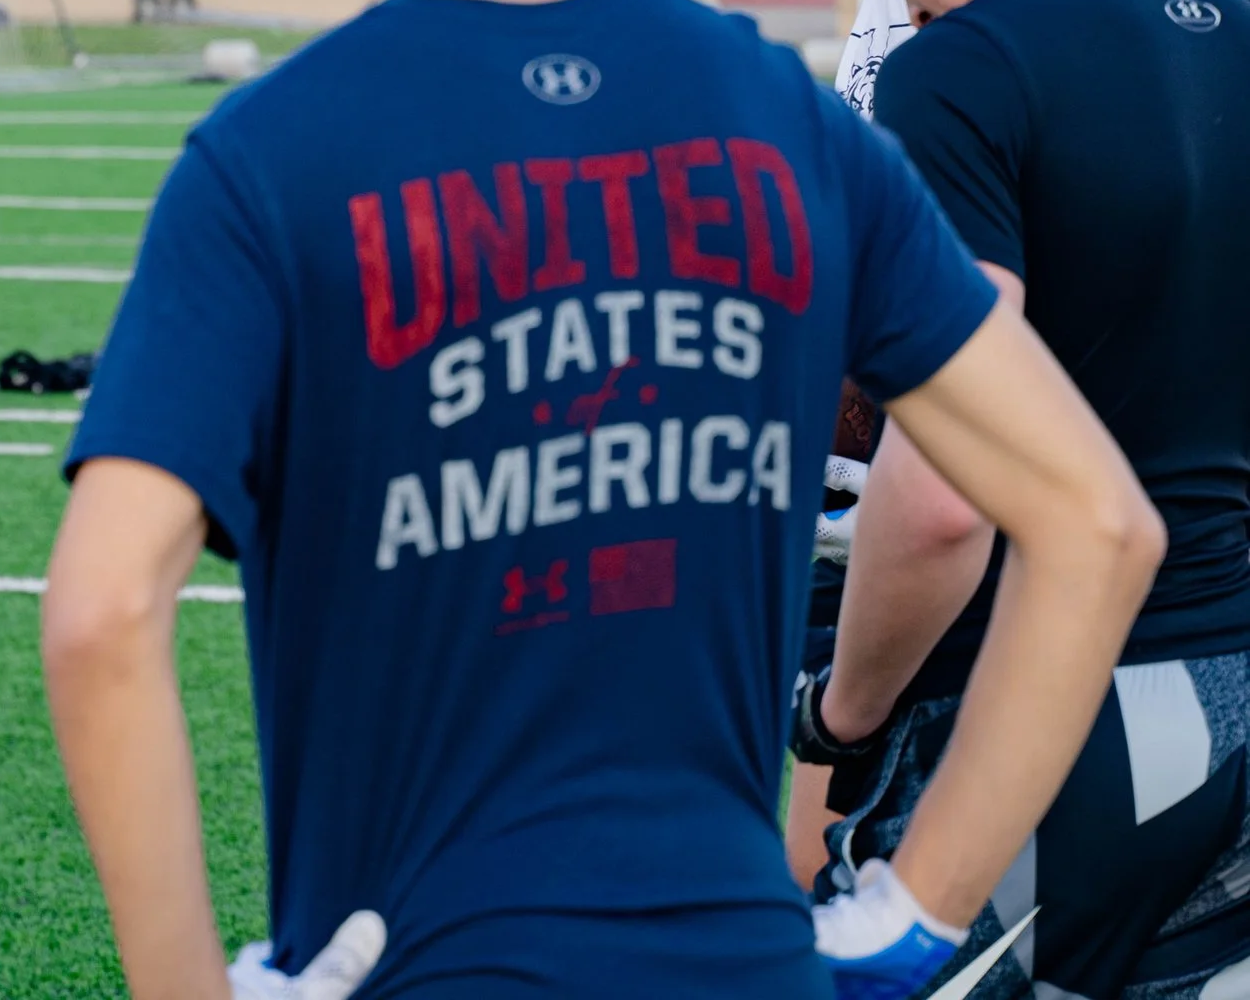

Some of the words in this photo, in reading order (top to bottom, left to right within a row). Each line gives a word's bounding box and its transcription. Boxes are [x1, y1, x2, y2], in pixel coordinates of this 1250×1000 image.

[349, 137, 814, 370] UNITED
[428, 289, 764, 428] STATES
[376, 415, 791, 570] AMERICA
